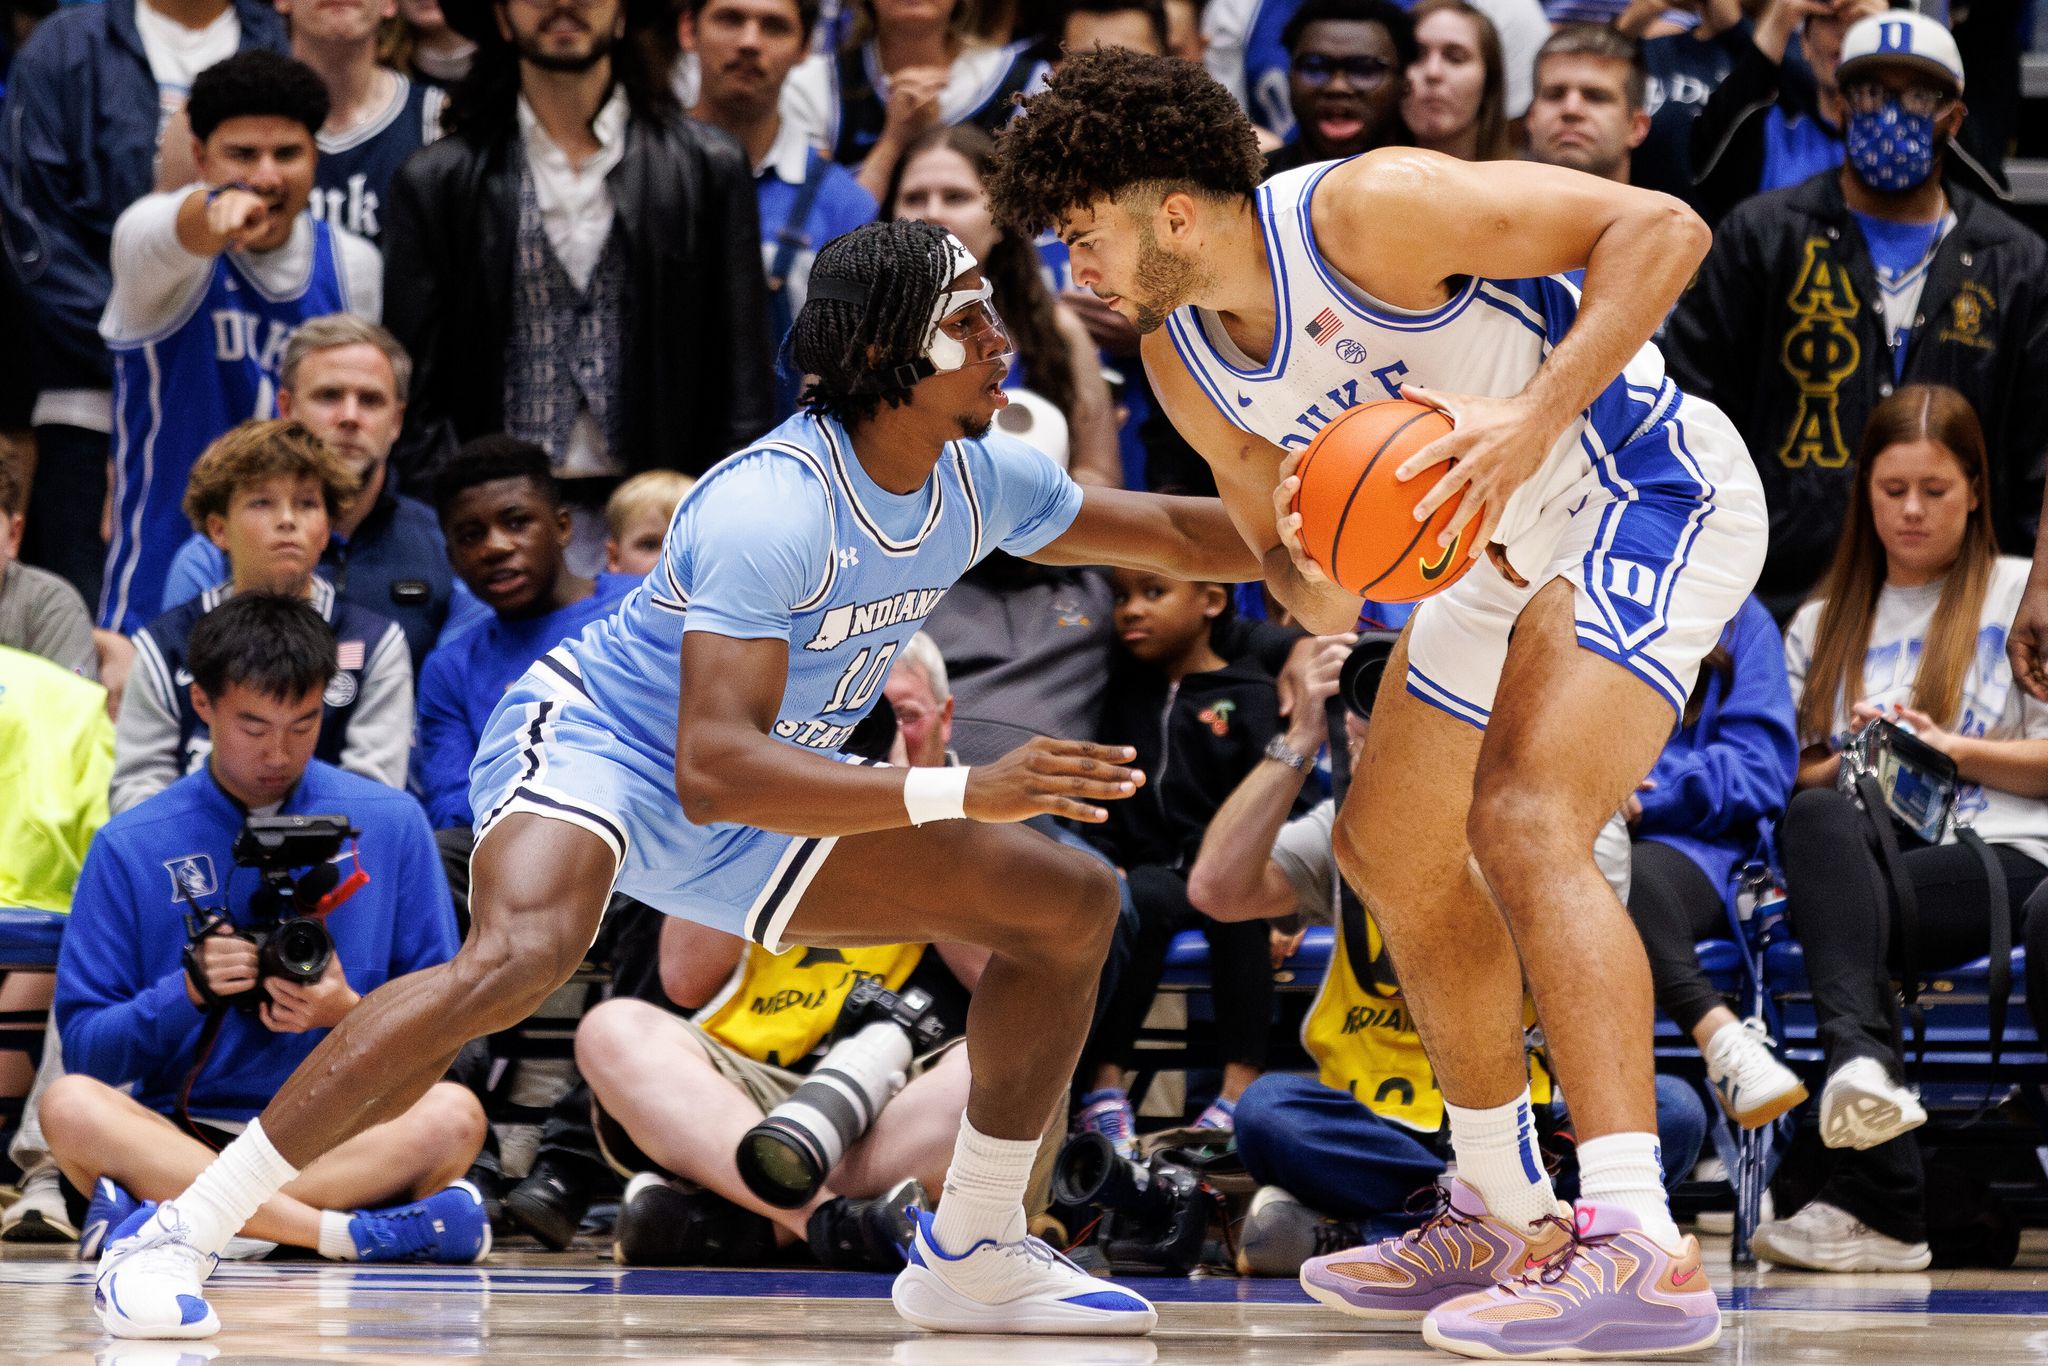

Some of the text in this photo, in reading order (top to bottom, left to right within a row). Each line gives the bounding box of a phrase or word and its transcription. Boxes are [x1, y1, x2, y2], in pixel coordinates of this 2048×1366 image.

[1607, 557, 1657, 607] D
[822, 640, 899, 713] 10
[773, 719, 857, 749] STAT
